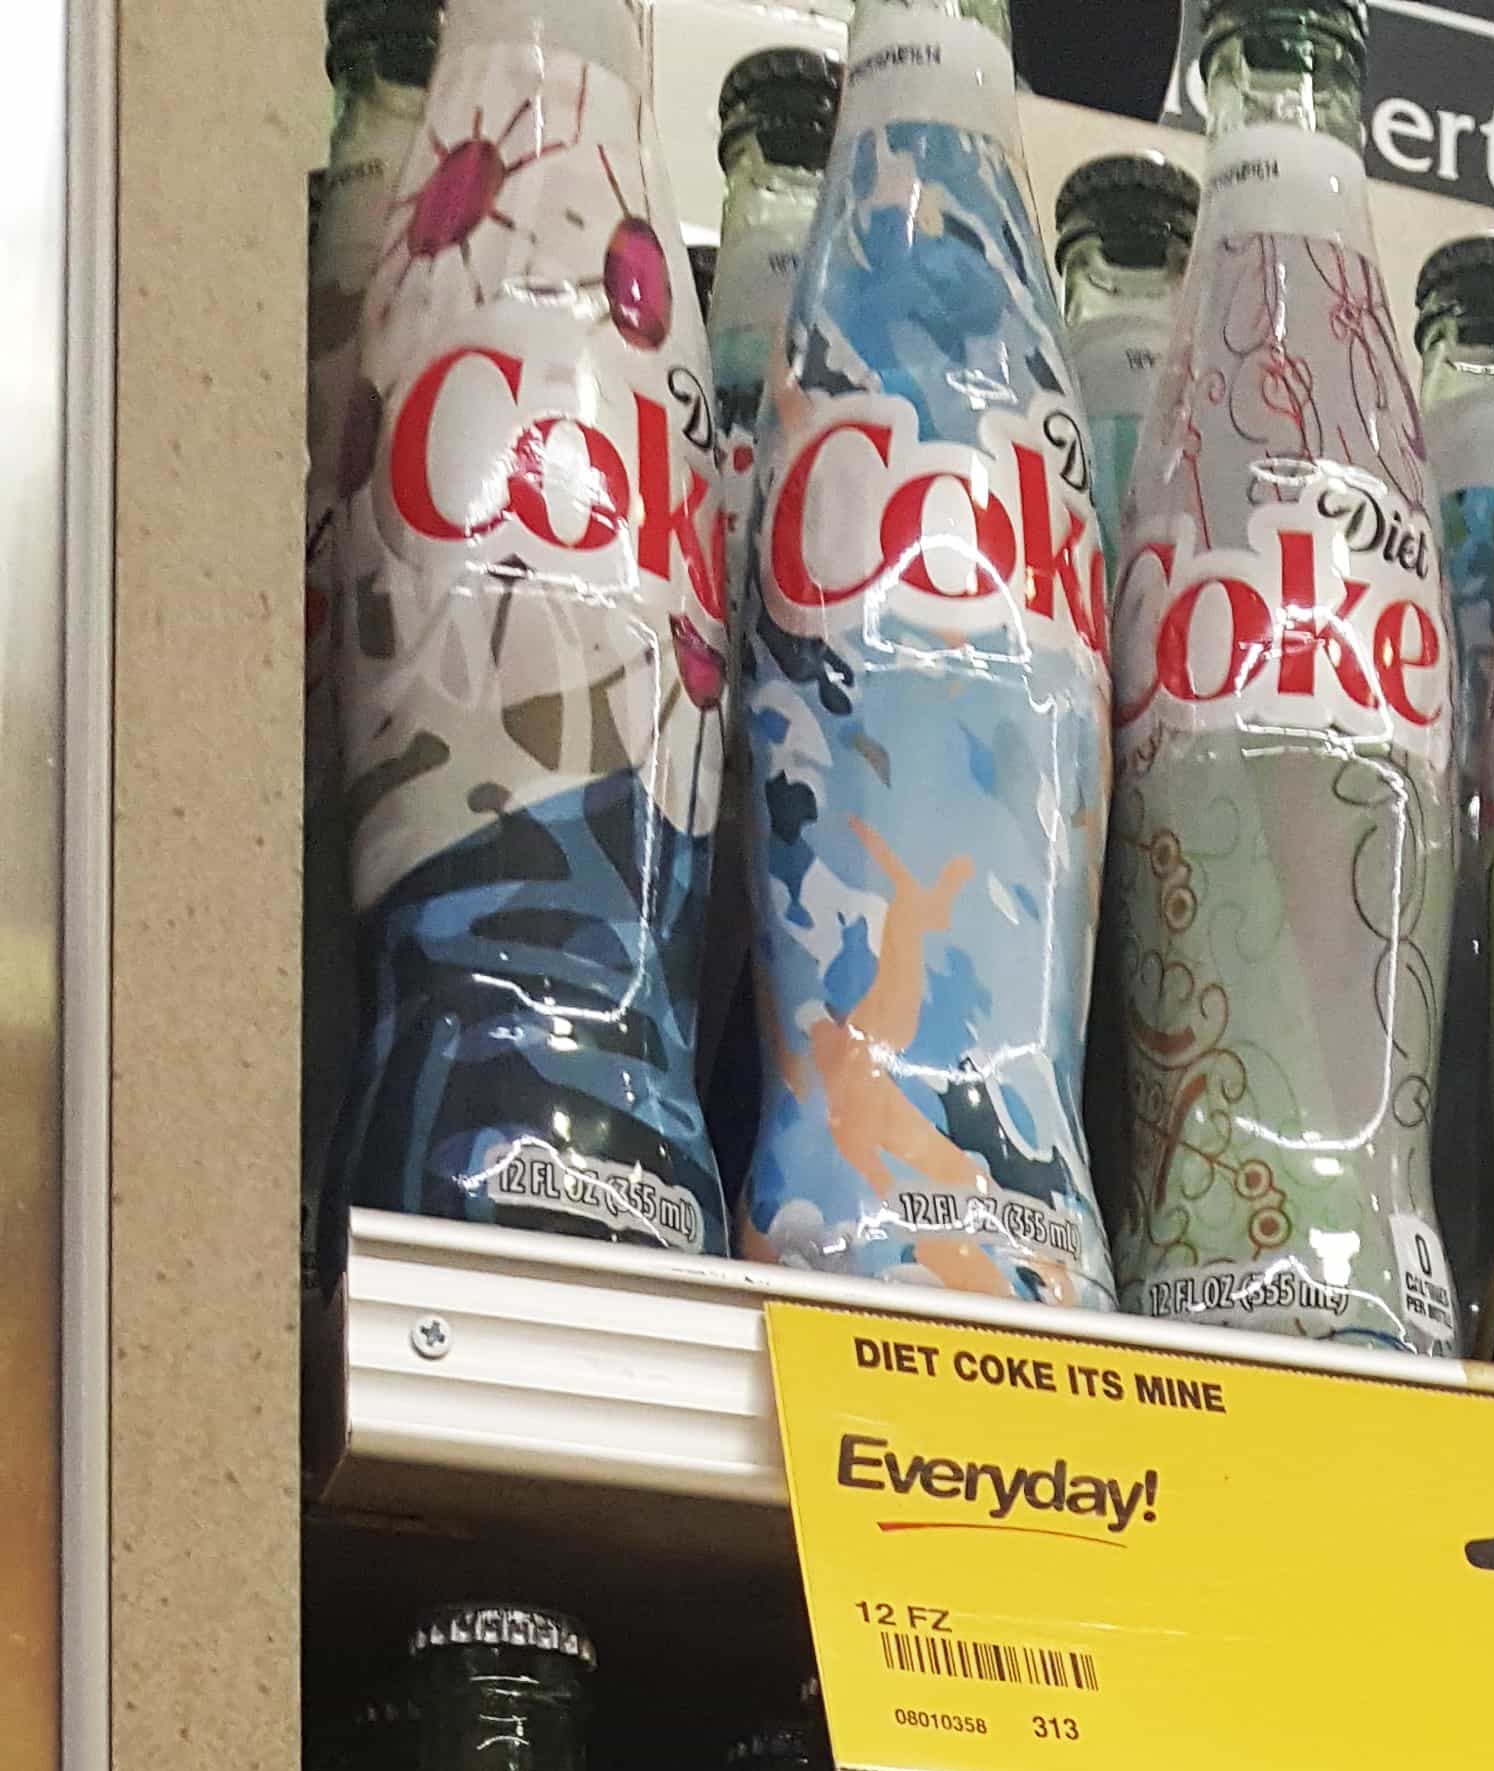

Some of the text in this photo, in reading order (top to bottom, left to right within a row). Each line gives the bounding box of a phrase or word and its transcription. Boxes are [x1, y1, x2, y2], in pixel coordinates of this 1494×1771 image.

[391, 347, 728, 620] Cok
[770, 422, 1108, 654] Cok
[1318, 483, 1430, 577] Diet
[1115, 531, 1443, 725] Coke
[499, 1158, 526, 1195] 12
[529, 1161, 559, 1199] FL
[604, 1169, 657, 1220] (355
[901, 1192, 931, 1226] 12
[932, 1194, 961, 1229] FL
[1001, 1199, 1049, 1243] (355
[1415, 1234, 1432, 1275] 0
[1150, 1278, 1170, 1316] 12
[1173, 1277, 1200, 1313] FL
[1204, 1272, 1233, 1310] OZ
[854, 1338, 1226, 1414] DIET COKE ITS MINE
[837, 1433, 1158, 1533] Everyday!
[855, 1601, 952, 1632] 12 FZ
[895, 1708, 1080, 1741] 08010358 313
